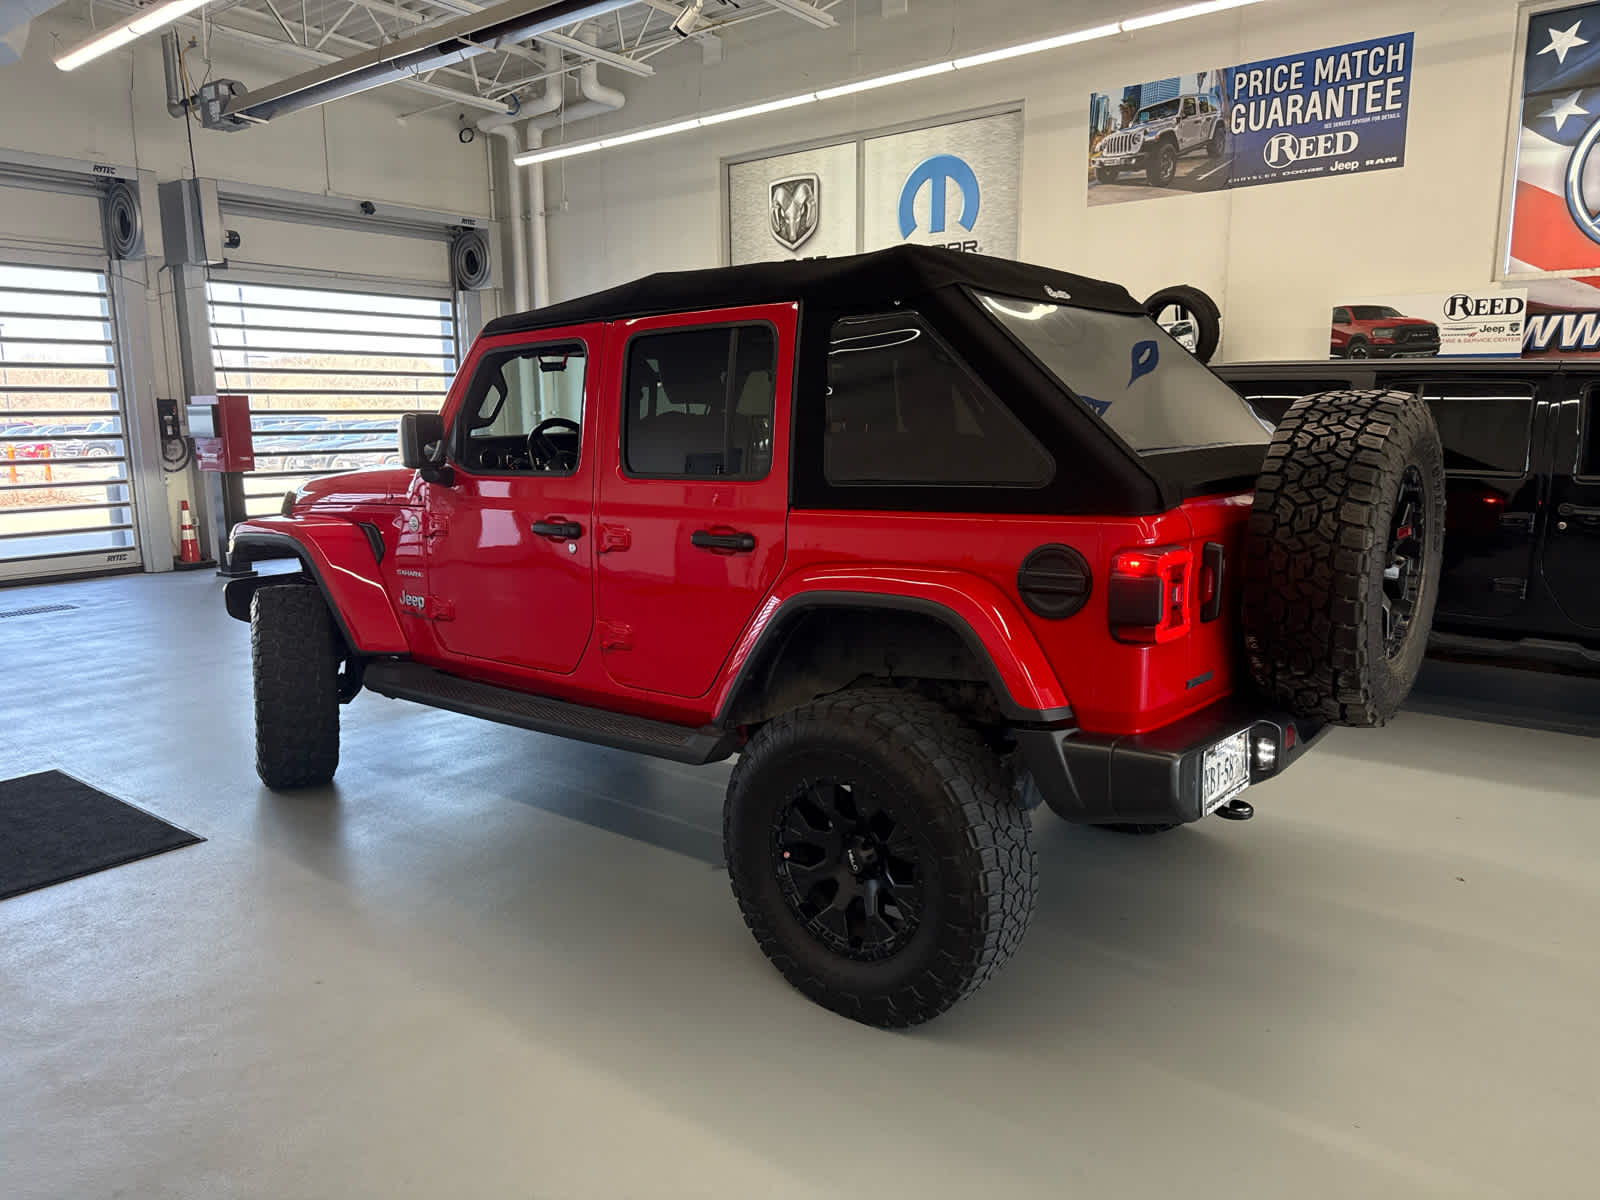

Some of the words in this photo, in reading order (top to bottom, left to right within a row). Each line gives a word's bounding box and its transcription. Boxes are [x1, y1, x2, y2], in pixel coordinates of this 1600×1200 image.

[1233, 61, 1305, 100] PRICE
[1313, 42, 1405, 86] MATCH
[1231, 76, 1404, 135] GUARANTEE
[1265, 131, 1359, 166] REED
[1228, 172, 1277, 184] CHRYSLER
[1282, 166, 1324, 176] DODGE
[1330, 159, 1359, 172] Jeep
[1365, 156, 1397, 166] RAM
[1446, 295, 1524, 318] REED
[1479, 324, 1505, 334] Jeep
[399, 590, 425, 610] Jeep
